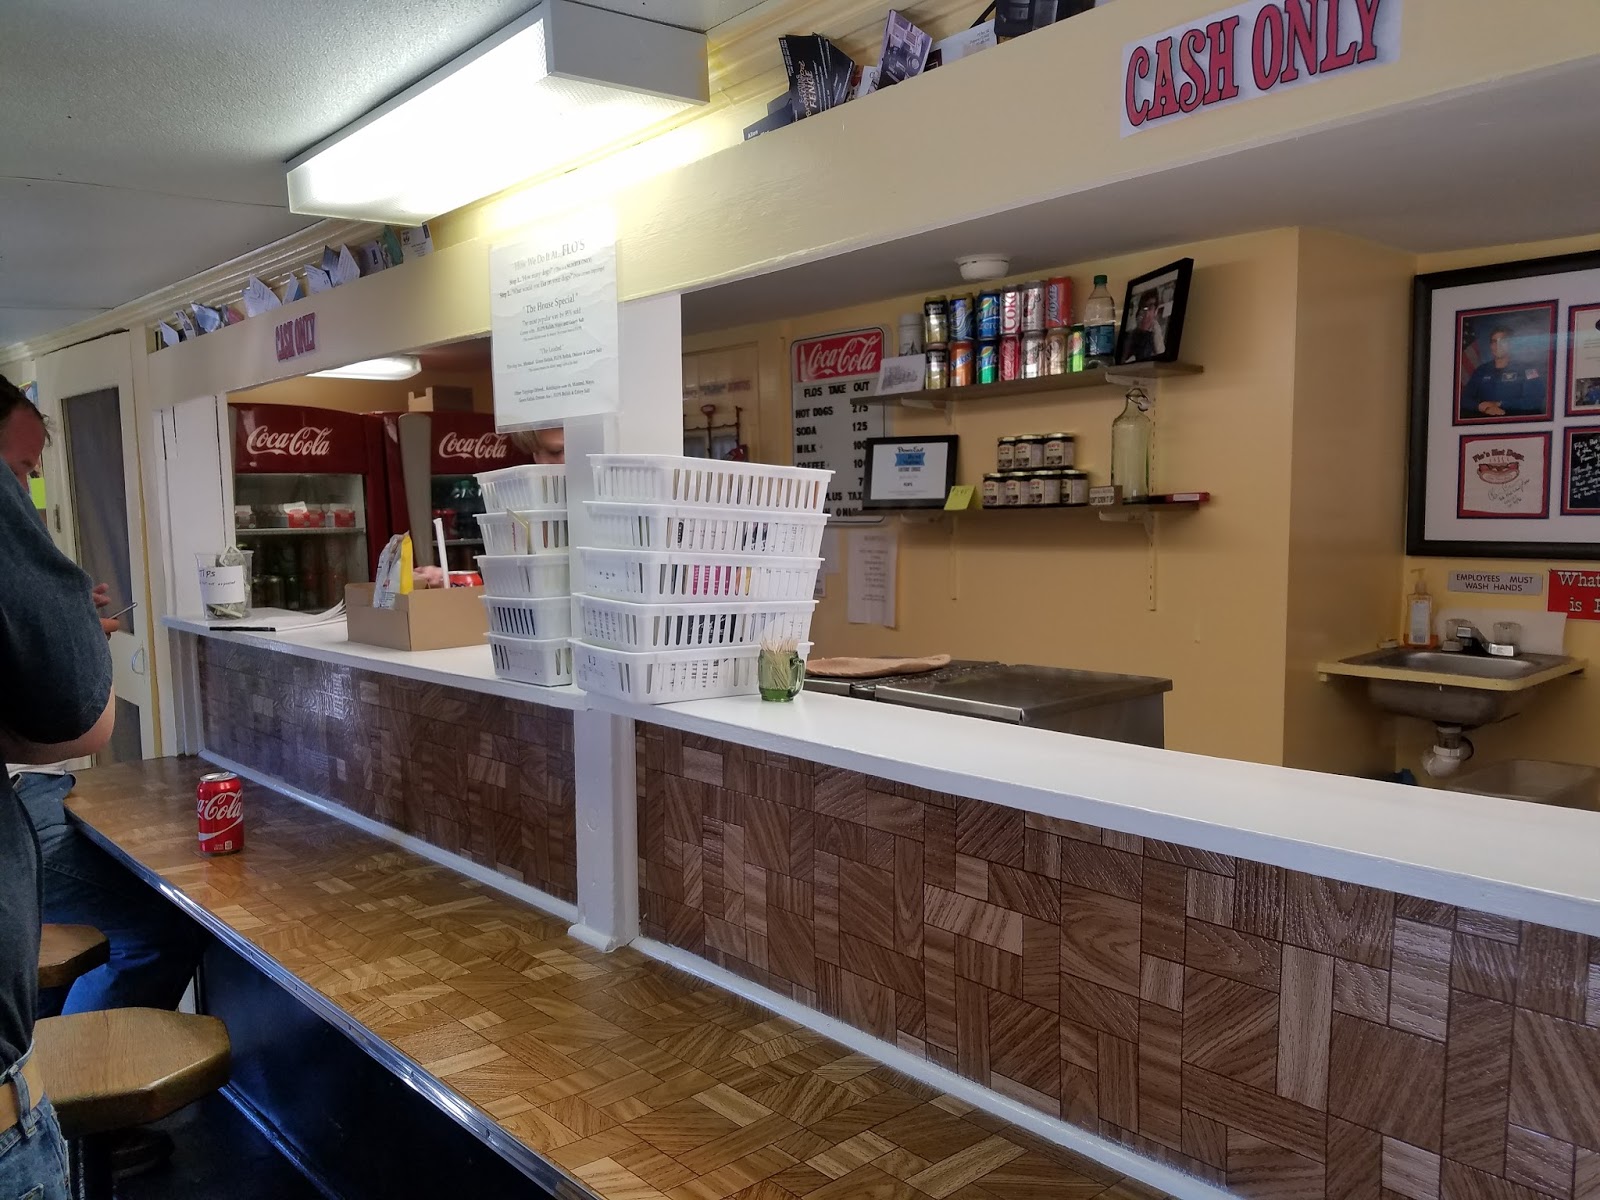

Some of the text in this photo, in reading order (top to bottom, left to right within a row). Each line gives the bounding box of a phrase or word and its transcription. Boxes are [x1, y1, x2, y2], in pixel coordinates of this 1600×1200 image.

[1125, 0, 1380, 127] CASH ONLY
[562, 240, 585, 256] FLO'S
[537, 301, 554, 311] House
[555, 294, 575, 308] Special
[808, 335, 880, 376] Coca-Cola
[804, 381, 869, 398] FLOS TAKE OUT
[795, 409, 810, 418] HOT
[813, 406, 833, 417] DOGS
[796, 422, 868, 436] SODA 125
[246, 425, 333, 455] Coca-Cola
[438, 431, 508, 458] Coca-Cola
[797, 444, 816, 453] MILK
[847, 492, 862, 500] TAX
[1456, 574, 1534, 584] EMPLOYEES MUST
[1558, 571, 1600, 587] What
[1493, 584, 1523, 592] HANDS
[1569, 596, 1582, 612] is
